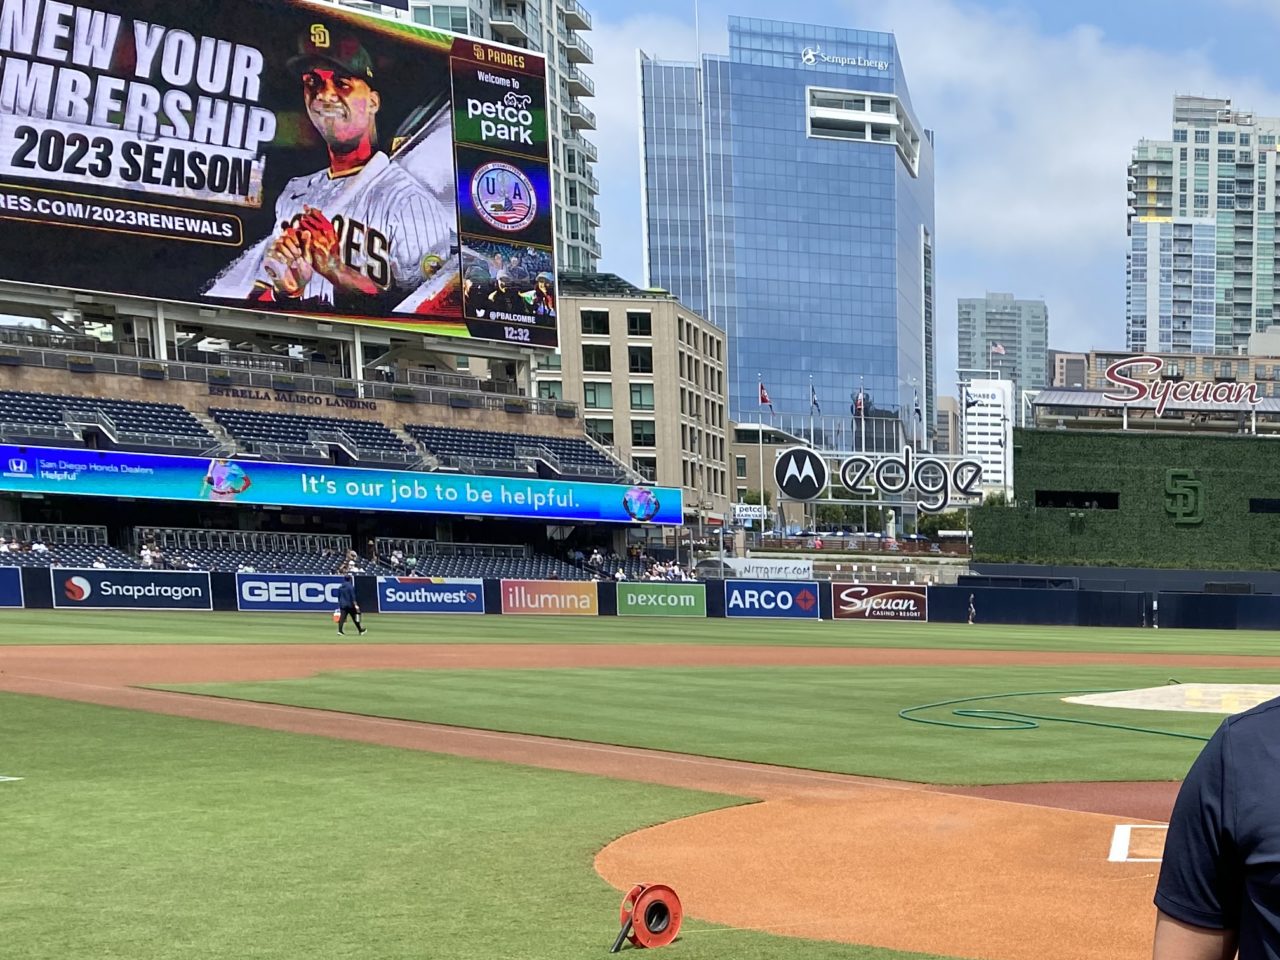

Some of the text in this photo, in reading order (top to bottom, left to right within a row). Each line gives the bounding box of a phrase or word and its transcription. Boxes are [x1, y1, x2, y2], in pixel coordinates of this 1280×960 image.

[133, 19, 264, 101] YOUR
[488, 49, 525, 68] PADRES
[820, 52, 889, 70] Sempra Energy
[477, 70, 520, 89] Welcome To
[0, 56, 277, 150] MBERSHIP
[467, 98, 533, 125] petco
[481, 120, 533, 145] park
[11, 125, 250, 196] 2023 SEASON
[489, 311, 537, 324] @PBALCOMBE
[504, 326, 531, 341] 12:32
[1103, 355, 1263, 417] Sycuan
[209, 386, 377, 411] ESTRELLA JALISCO LANDING
[39, 459, 154, 475] San Diego Honda Dealers
[40, 470, 77, 482] Helpful
[840, 445, 985, 514] edge
[301, 473, 580, 511] It's our job to be helpful.
[100, 581, 202, 600] Snapdragon
[242, 581, 341, 603] GEICO
[385, 587, 466, 604] Southwest
[508, 586, 592, 609] illumina
[728, 589, 793, 610] ARCO
[839, 587, 917, 617] Sycuan
